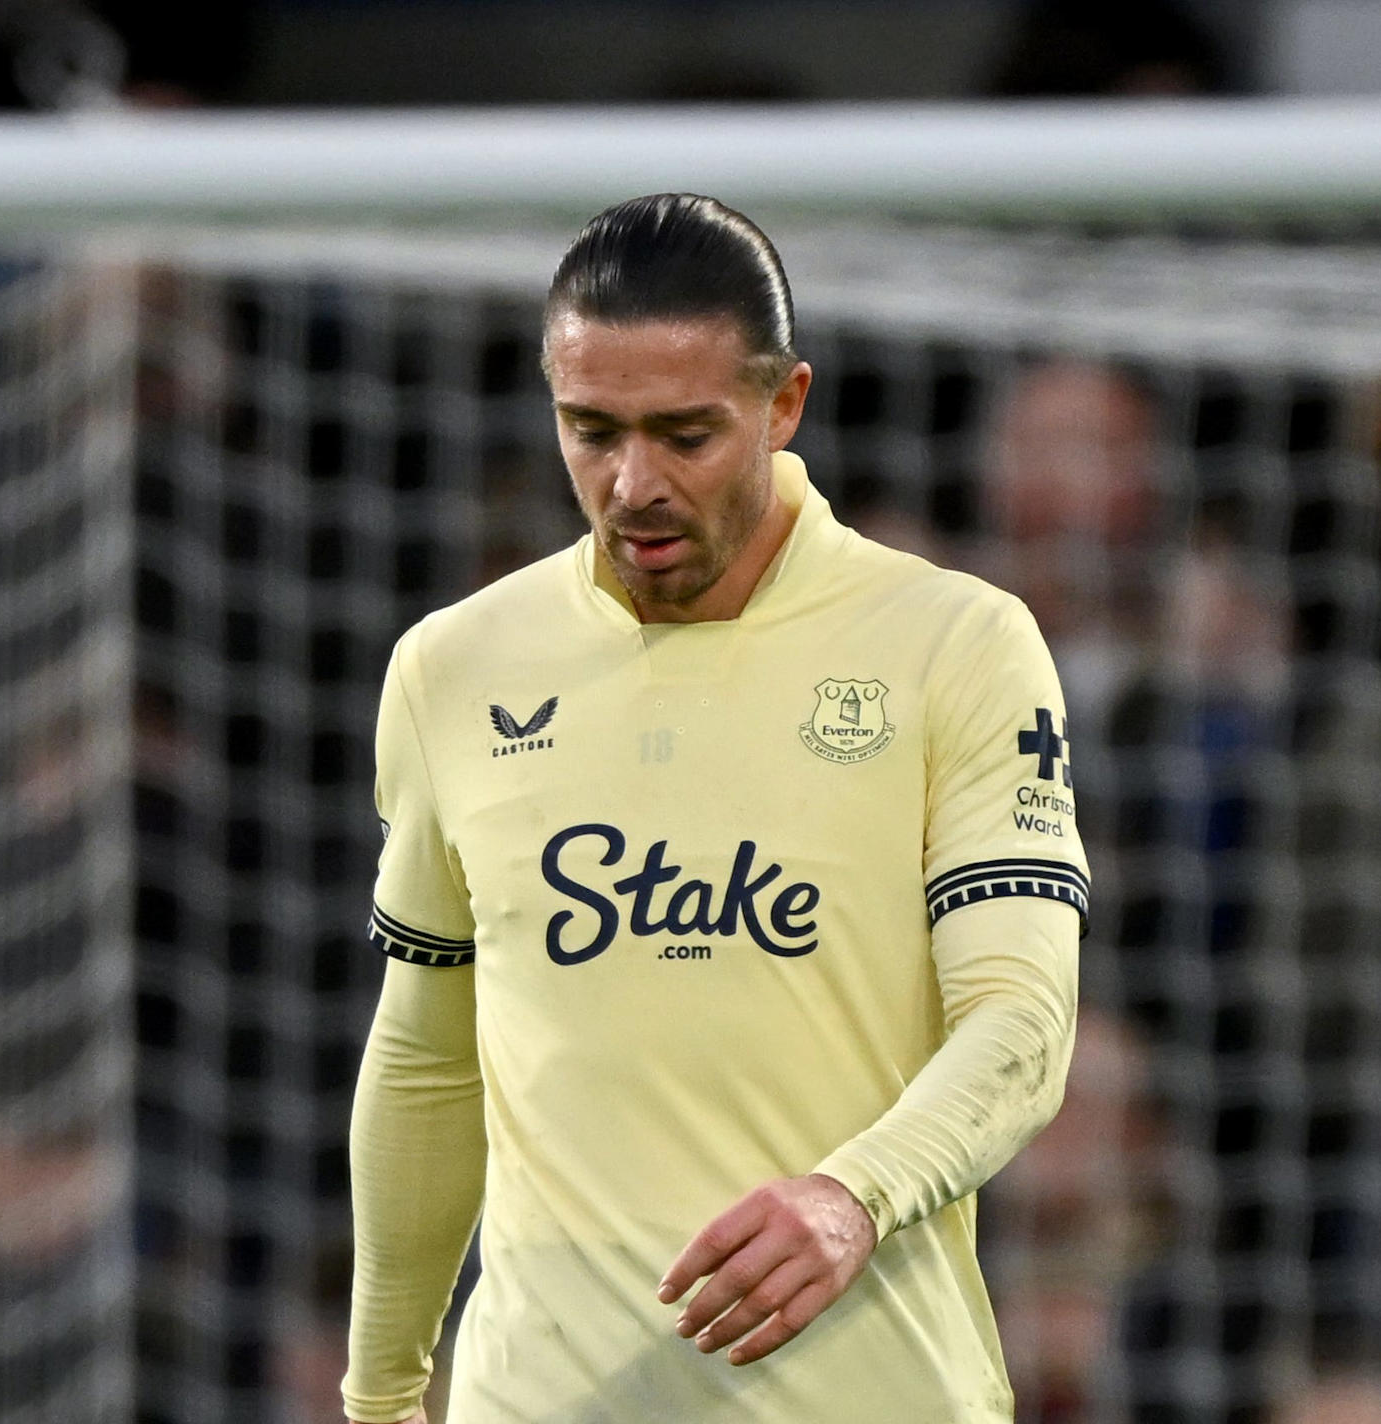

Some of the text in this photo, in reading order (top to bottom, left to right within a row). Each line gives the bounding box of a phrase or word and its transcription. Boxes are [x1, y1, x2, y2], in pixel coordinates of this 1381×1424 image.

[822, 725, 874, 737] Everton
[492, 738, 554, 758] CASTORE
[1016, 786, 1075, 816] Christo
[1012, 810, 1064, 837] Ward
[541, 823, 820, 966] Stake
[656, 941, 712, 961] .com
